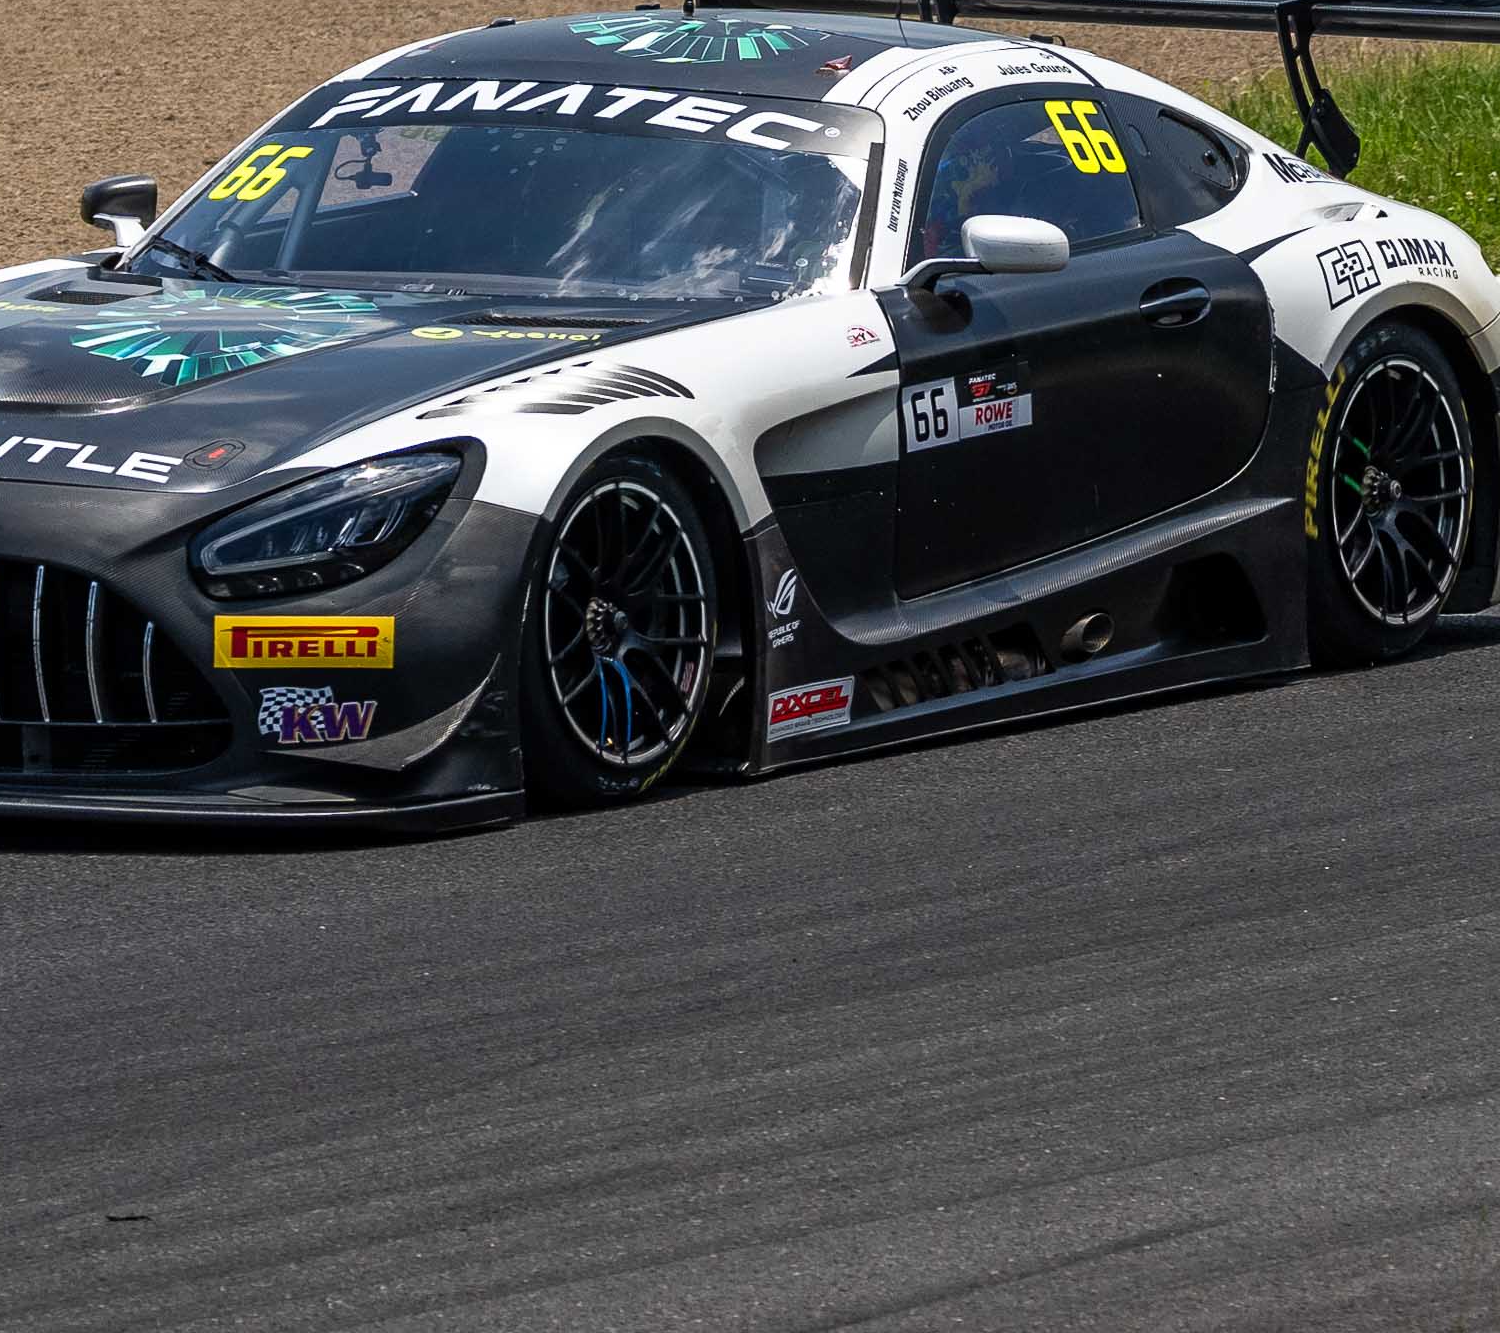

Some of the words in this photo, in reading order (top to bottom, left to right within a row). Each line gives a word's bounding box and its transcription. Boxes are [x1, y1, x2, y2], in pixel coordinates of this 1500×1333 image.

[996, 64, 1029, 77] Jules
[309, 80, 825, 152] FANATEC
[902, 96, 932, 122] Zhou
[925, 76, 975, 102] Bihuang
[1043, 99, 1128, 174] 66
[207, 142, 315, 202] 66
[1375, 237, 1455, 270] CLIMAX
[1418, 267, 1460, 281] RACING
[968, 373, 997, 385] FANATEC
[910, 386, 950, 444] 66
[974, 400, 1013, 426] ROWE
[231, 626, 380, 659] PIRELLI
[277, 700, 379, 744] KW
[770, 685, 850, 724] DIXCEL
